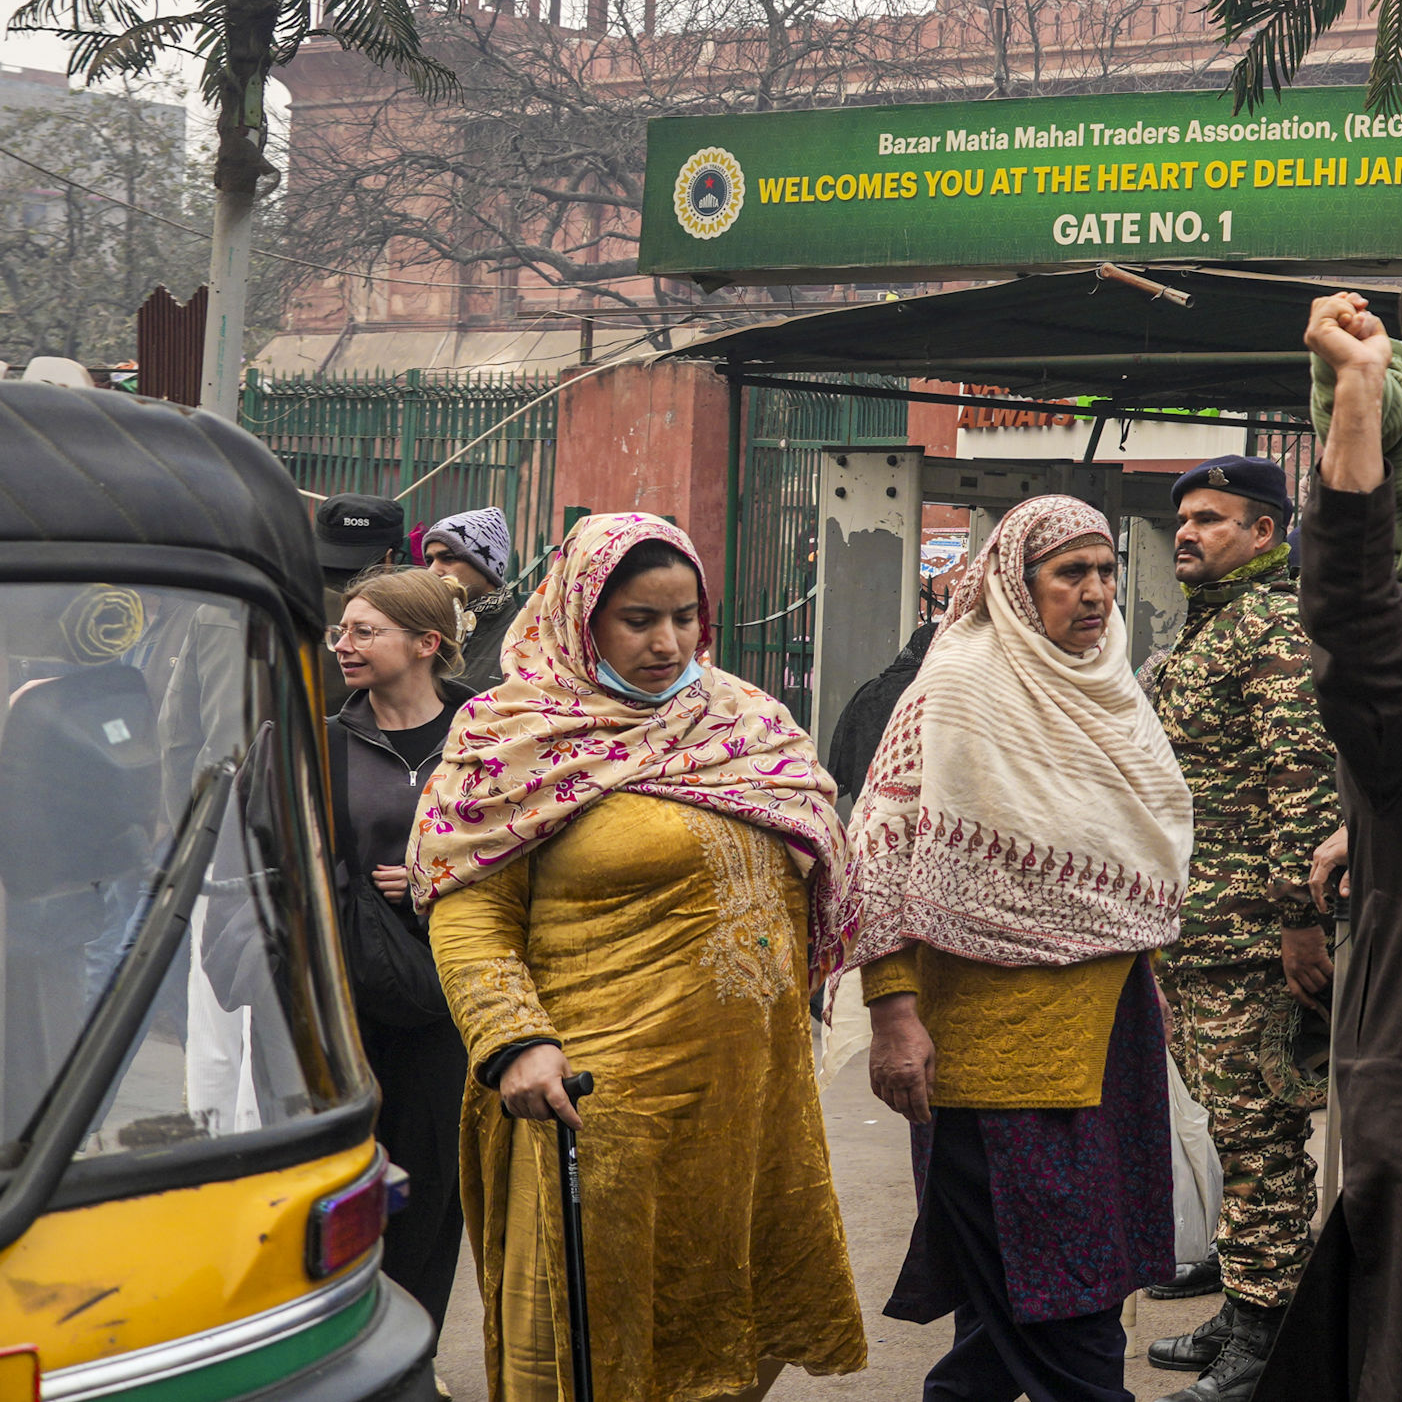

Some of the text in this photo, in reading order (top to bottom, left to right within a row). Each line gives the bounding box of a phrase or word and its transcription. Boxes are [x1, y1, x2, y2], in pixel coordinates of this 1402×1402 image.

[878, 133, 941, 155] Bazar
[946, 127, 1009, 153] Matia
[1014, 123, 1085, 149] Mahal
[1090, 121, 1180, 146] Traders
[1185, 115, 1338, 143] Association,
[758, 172, 918, 204] WELCOMES
[923, 169, 984, 198] YOU
[990, 167, 1027, 195] AT
[1033, 165, 1091, 194] THE
[1097, 161, 1199, 192] HEART
[1204, 160, 1248, 189] OF
[1253, 157, 1347, 188] DELHI
[1053, 210, 1233, 246] GATE NO. 1
[343, 517, 370, 527] BOSS
